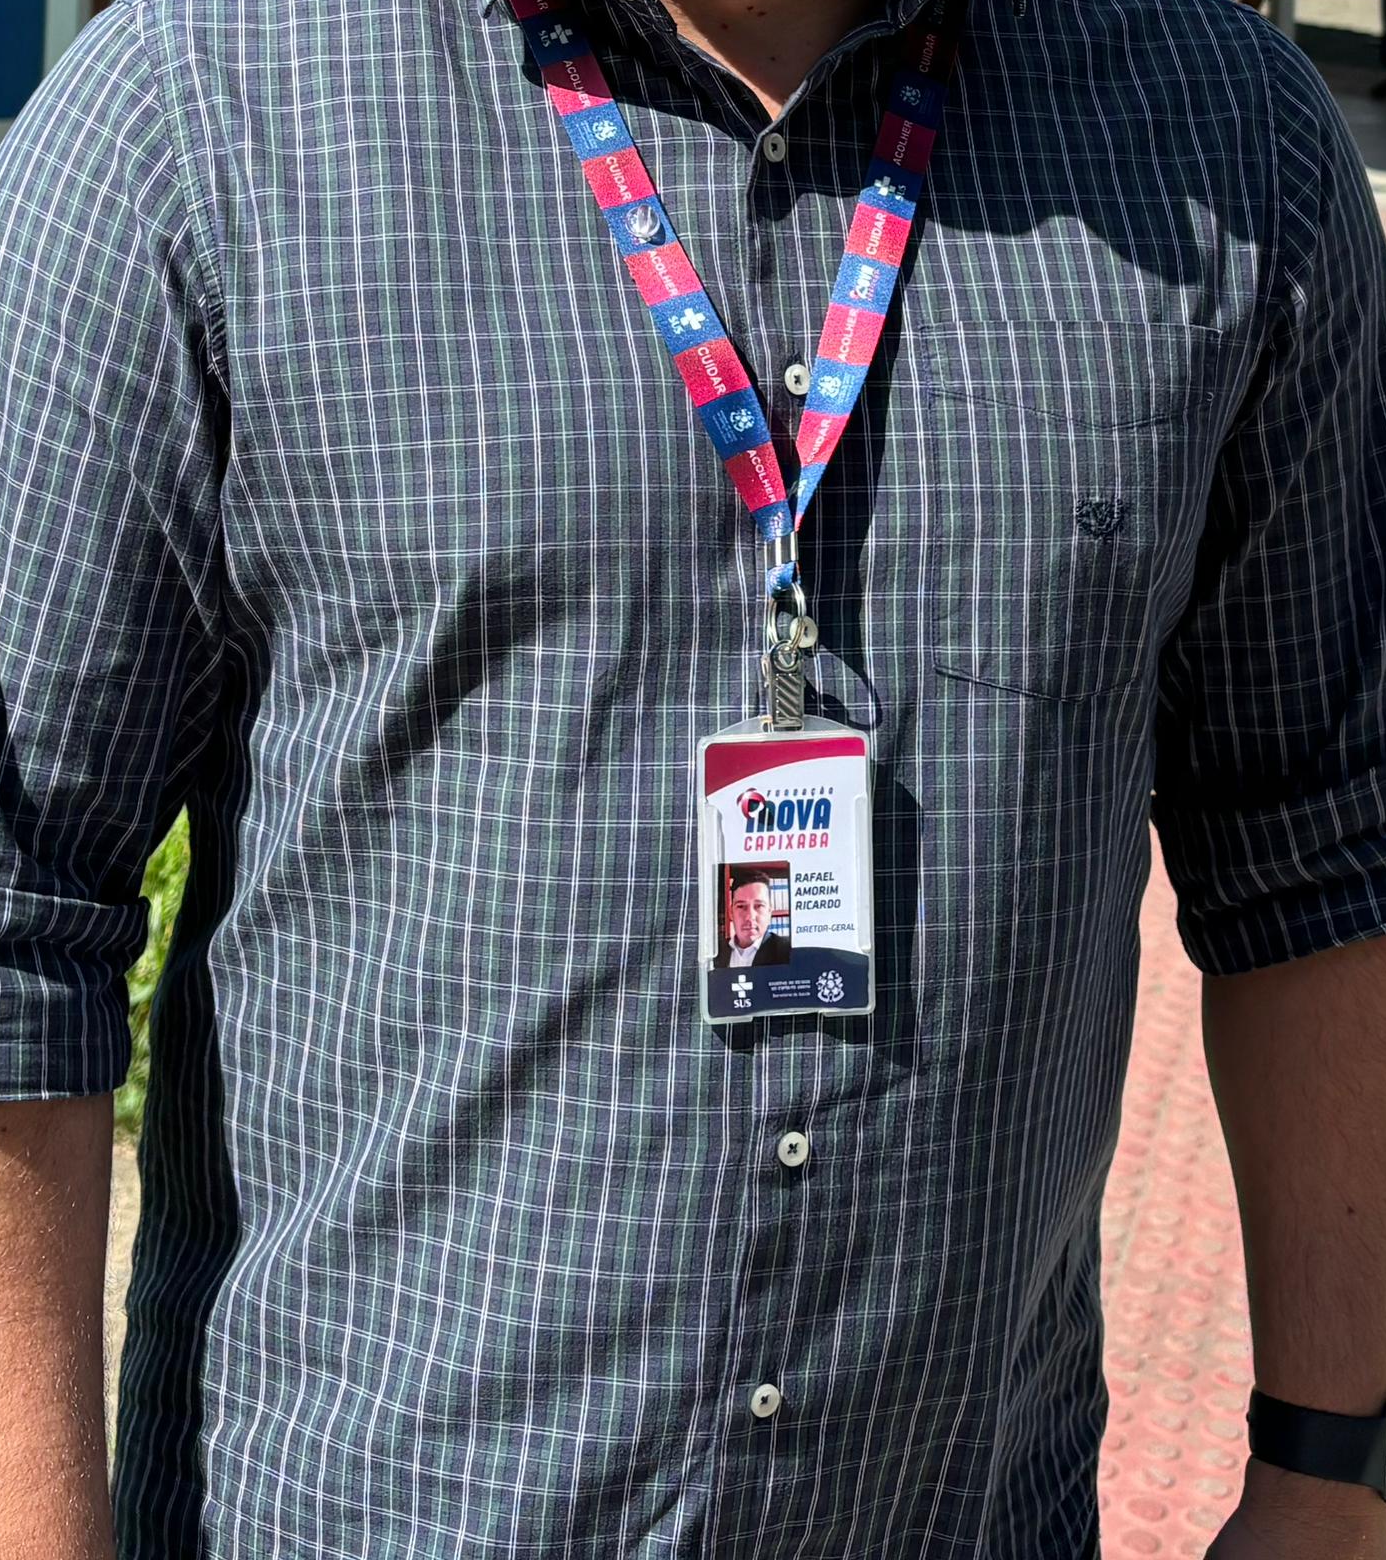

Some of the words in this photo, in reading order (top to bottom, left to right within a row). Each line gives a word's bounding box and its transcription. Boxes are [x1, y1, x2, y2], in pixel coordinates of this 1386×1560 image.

[892, 120, 914, 166] ACOLHER
[606, 156, 632, 201] CUIDAR
[866, 212, 887, 255] CUIDAR
[648, 249, 679, 297] ACOLHER
[837, 308, 859, 362] ACOLHER
[697, 346, 727, 396] CUIDAR
[744, 832, 829, 852] CAPIXABA
[794, 872, 835, 883] RAFAEL
[795, 885, 839, 897] AMORIM
[795, 899, 841, 910] RICARDO
[796, 923, 855, 934] DIRETOR-GERAL
[733, 999, 752, 1008] SUS
